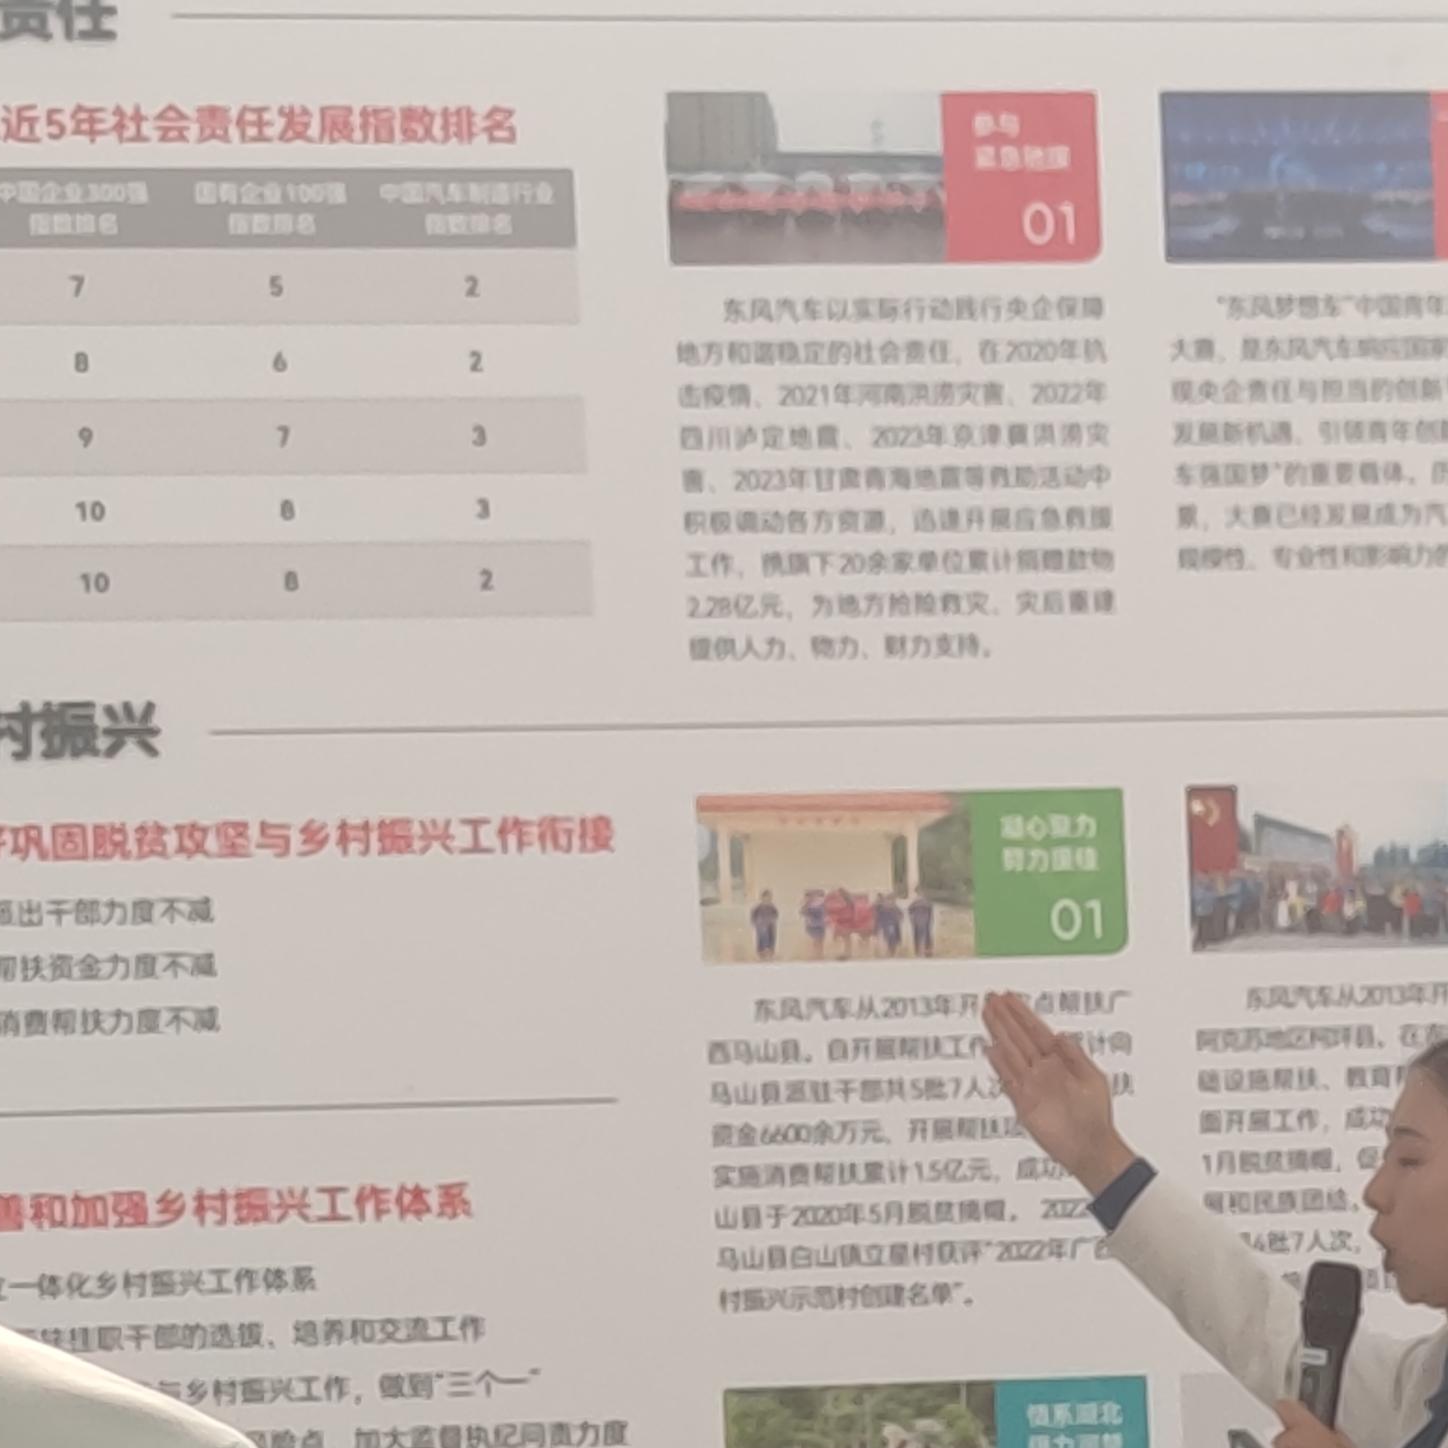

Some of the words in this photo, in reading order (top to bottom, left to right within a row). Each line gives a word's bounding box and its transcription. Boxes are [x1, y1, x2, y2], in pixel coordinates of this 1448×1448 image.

[1022, 200, 1078, 247] 01
[68, 275, 85, 298] 7
[269, 275, 283, 297] 5
[464, 275, 480, 297] 2
[74, 351, 89, 373] 8
[272, 350, 288, 373] 6
[469, 350, 483, 372] 2
[78, 426, 93, 448] 9
[276, 425, 290, 448] 7
[472, 424, 487, 447] 3
[75, 500, 106, 522] 10
[280, 499, 295, 521] 8
[476, 497, 490, 520] 3
[80, 572, 110, 594] 10
[284, 570, 299, 592] 8
[479, 568, 494, 591] 2
[1050, 897, 1104, 941] 01
[144, 1367, 542, 1405] 与乡村振兴工作，做到“三个一”
